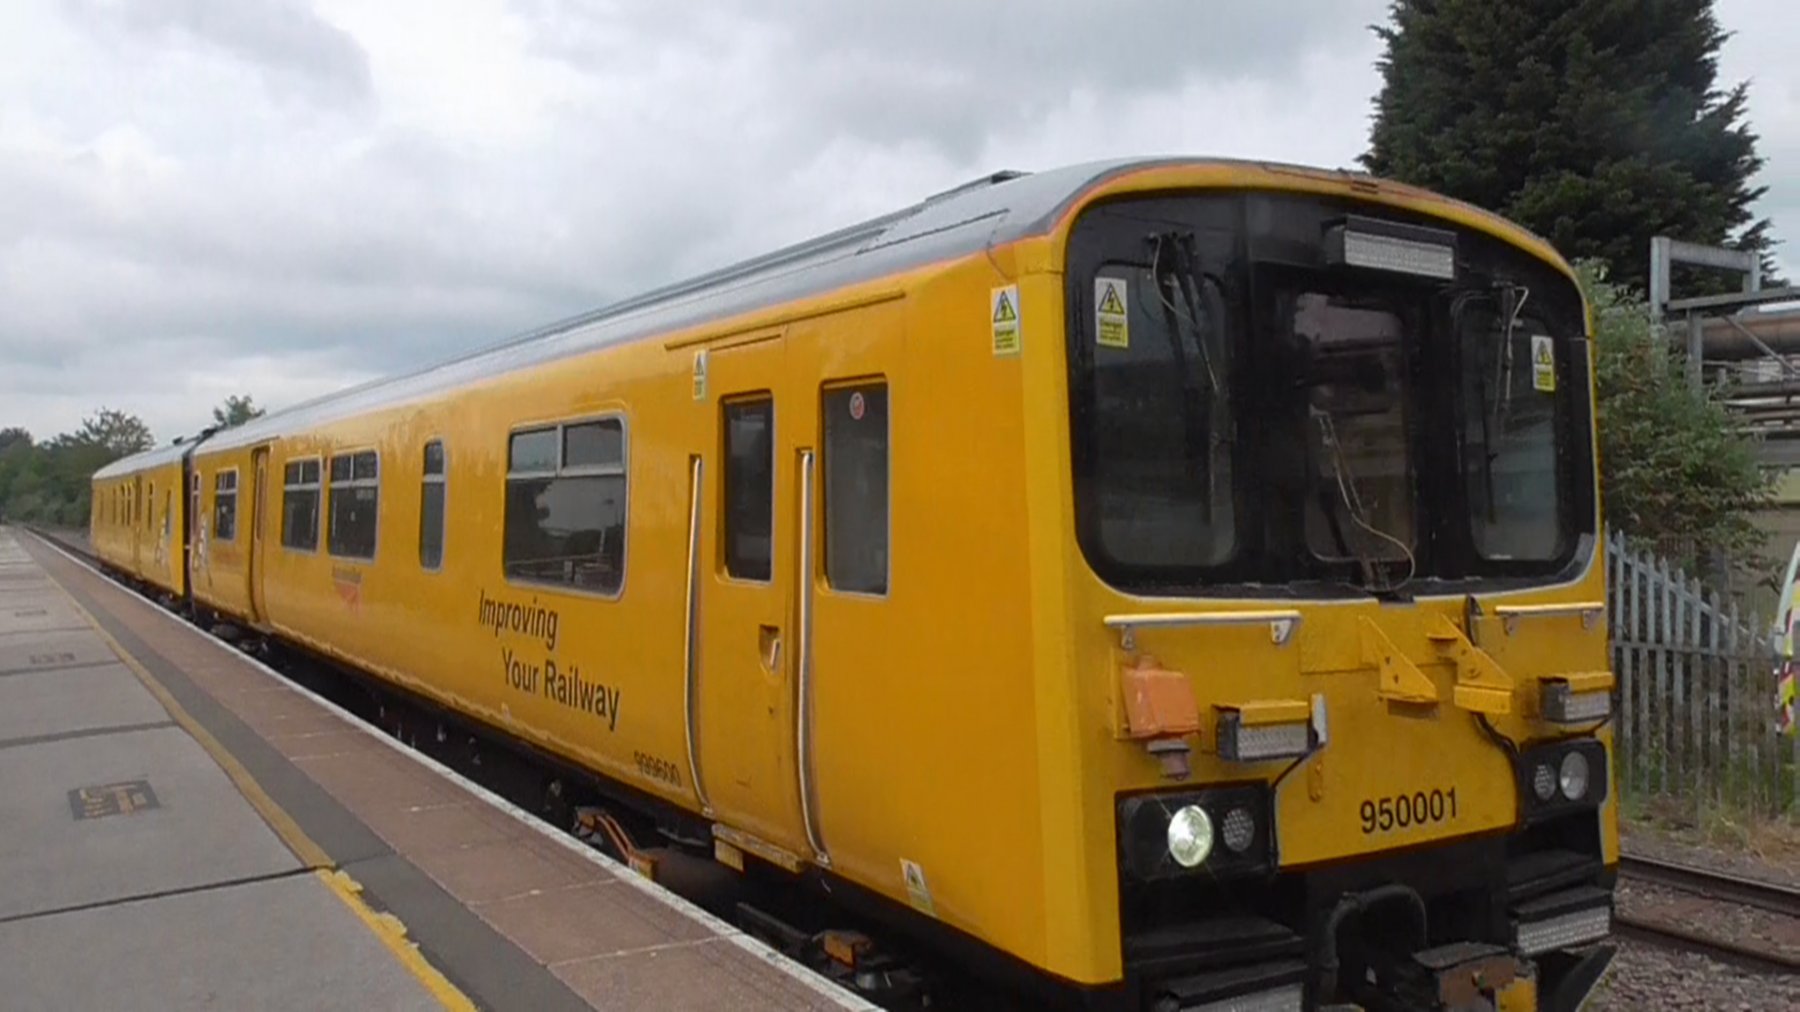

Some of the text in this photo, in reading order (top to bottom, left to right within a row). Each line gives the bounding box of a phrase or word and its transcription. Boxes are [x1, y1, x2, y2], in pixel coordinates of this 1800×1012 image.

[479, 588, 558, 650] Improving
[501, 646, 620, 732] Your Railway
[1360, 786, 1456, 834] 950001
